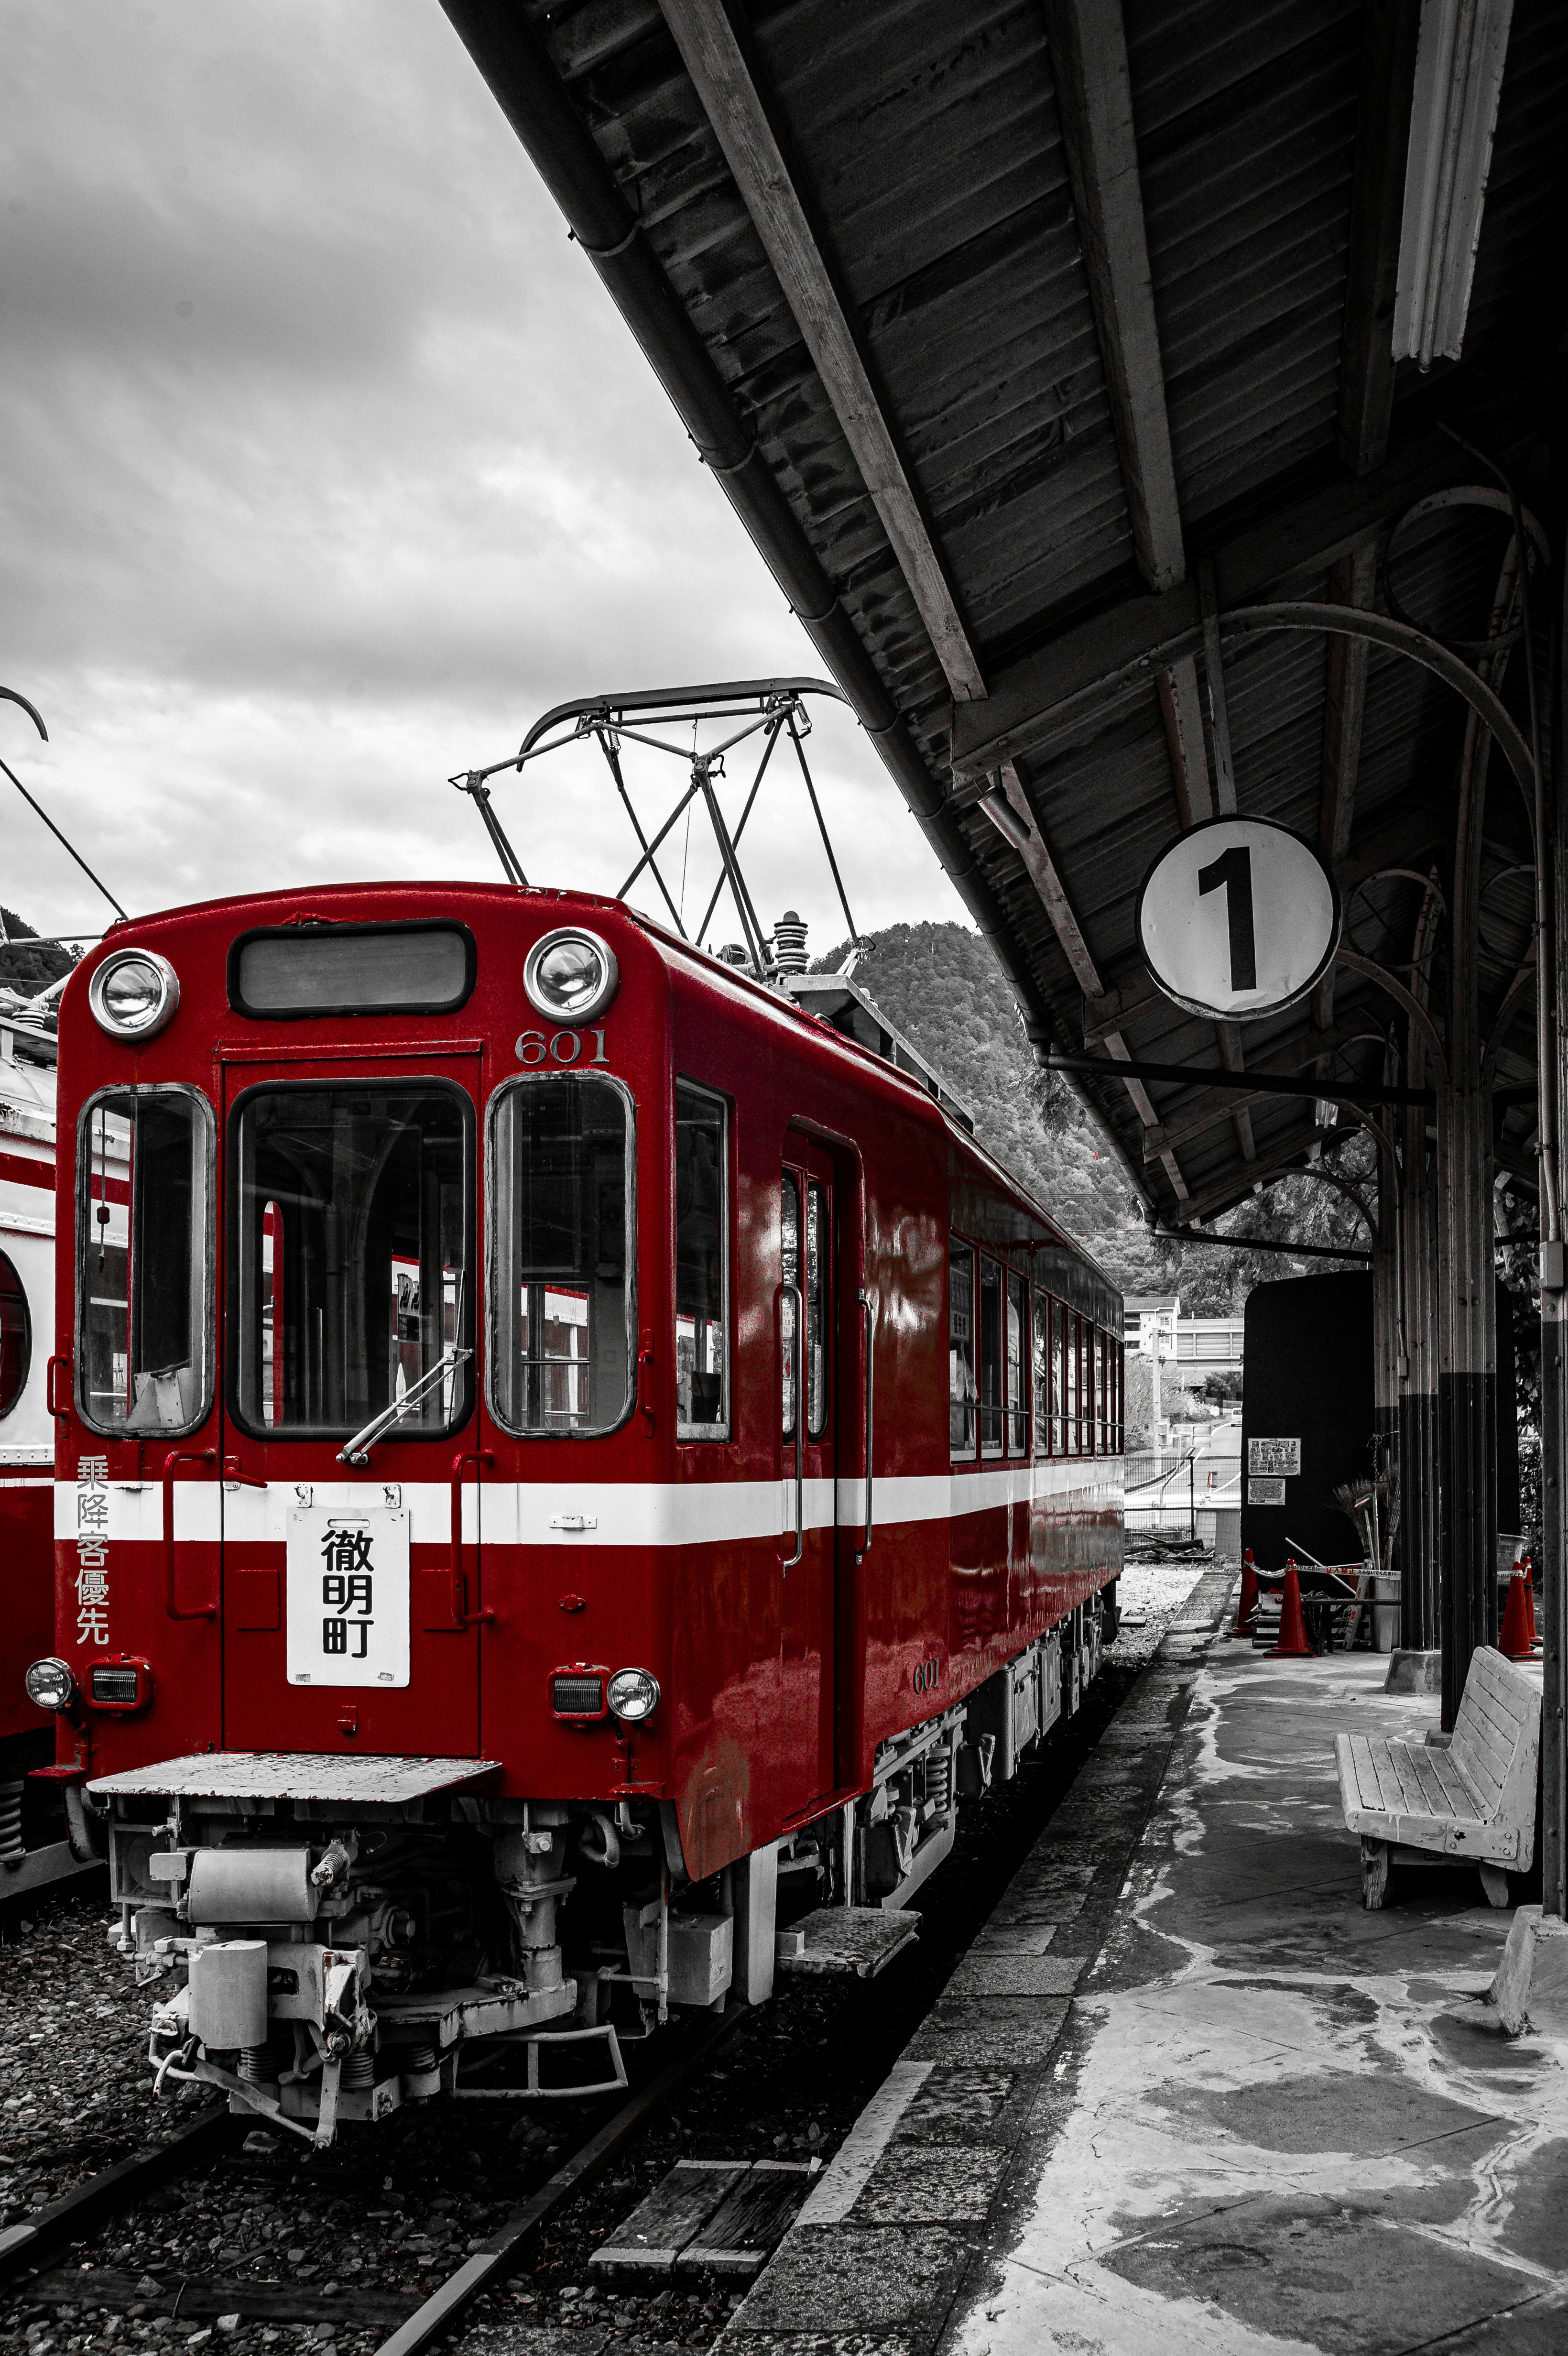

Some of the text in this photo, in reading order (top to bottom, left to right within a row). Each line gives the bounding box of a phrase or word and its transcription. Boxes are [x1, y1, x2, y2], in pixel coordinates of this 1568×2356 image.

[1198, 846, 1257, 992] 1
[515, 1030, 610, 1065] 601
[75, 1455, 109, 1645] 乗降客優先
[321, 1529, 374, 1658] 徹明町
[915, 1657, 939, 1694] 601
